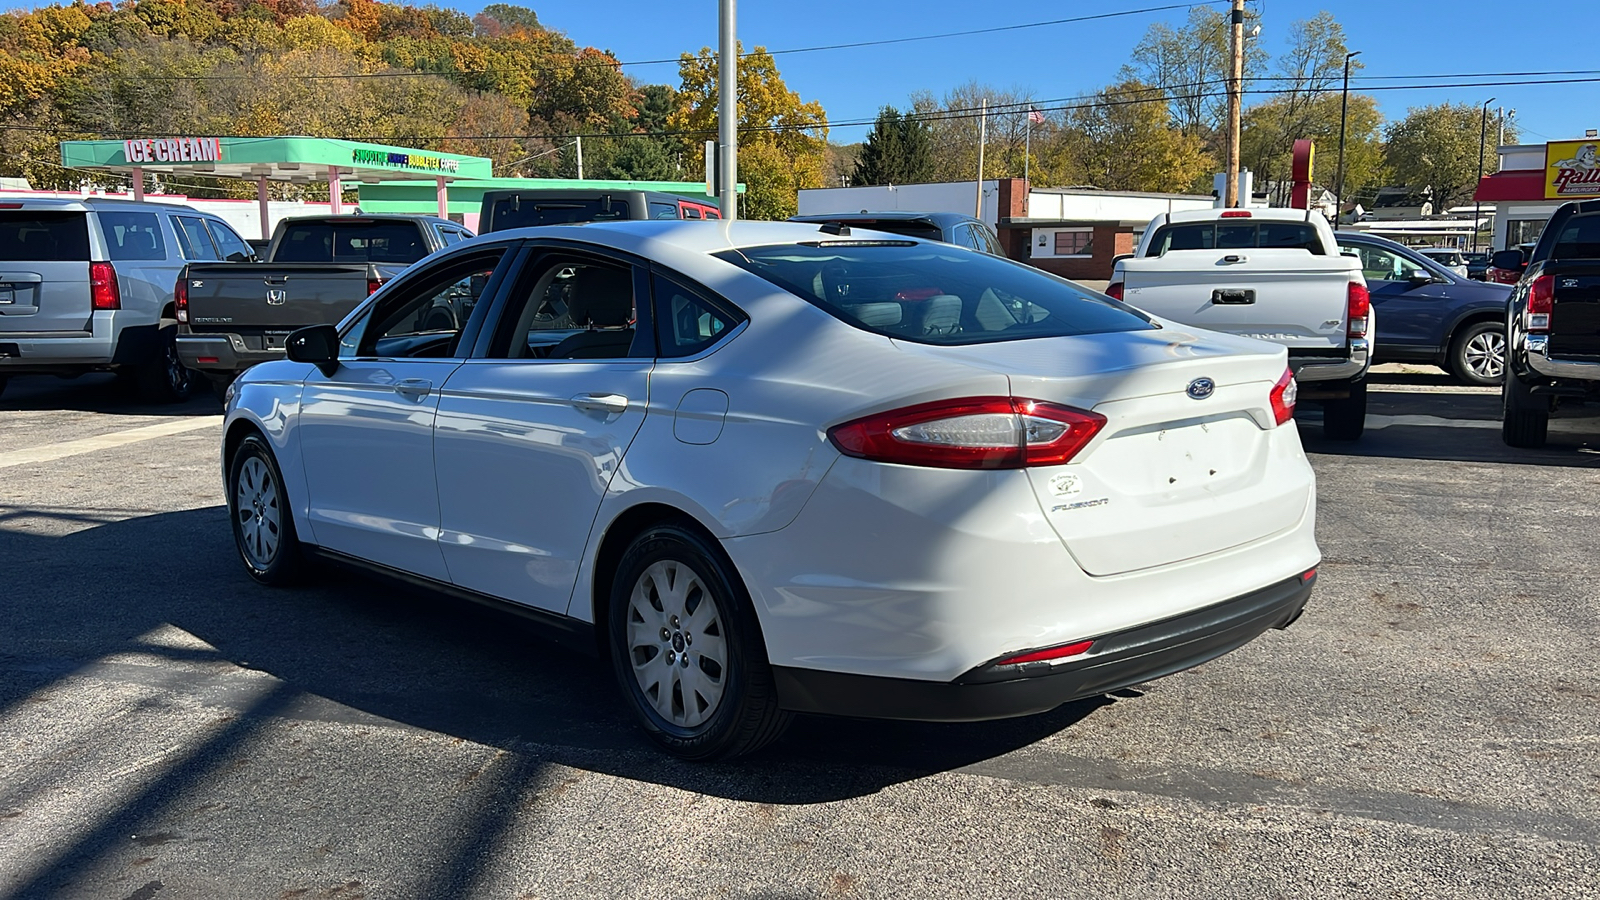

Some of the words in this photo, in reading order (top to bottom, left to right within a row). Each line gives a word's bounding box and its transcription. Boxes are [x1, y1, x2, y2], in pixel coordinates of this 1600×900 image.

[123, 139, 154, 162] ICE
[155, 138, 221, 161] CREAM
[353, 149, 388, 163] SMOOTHIE
[440, 158, 459, 170] COFFEE
[1051, 498, 1108, 512] FUSION
